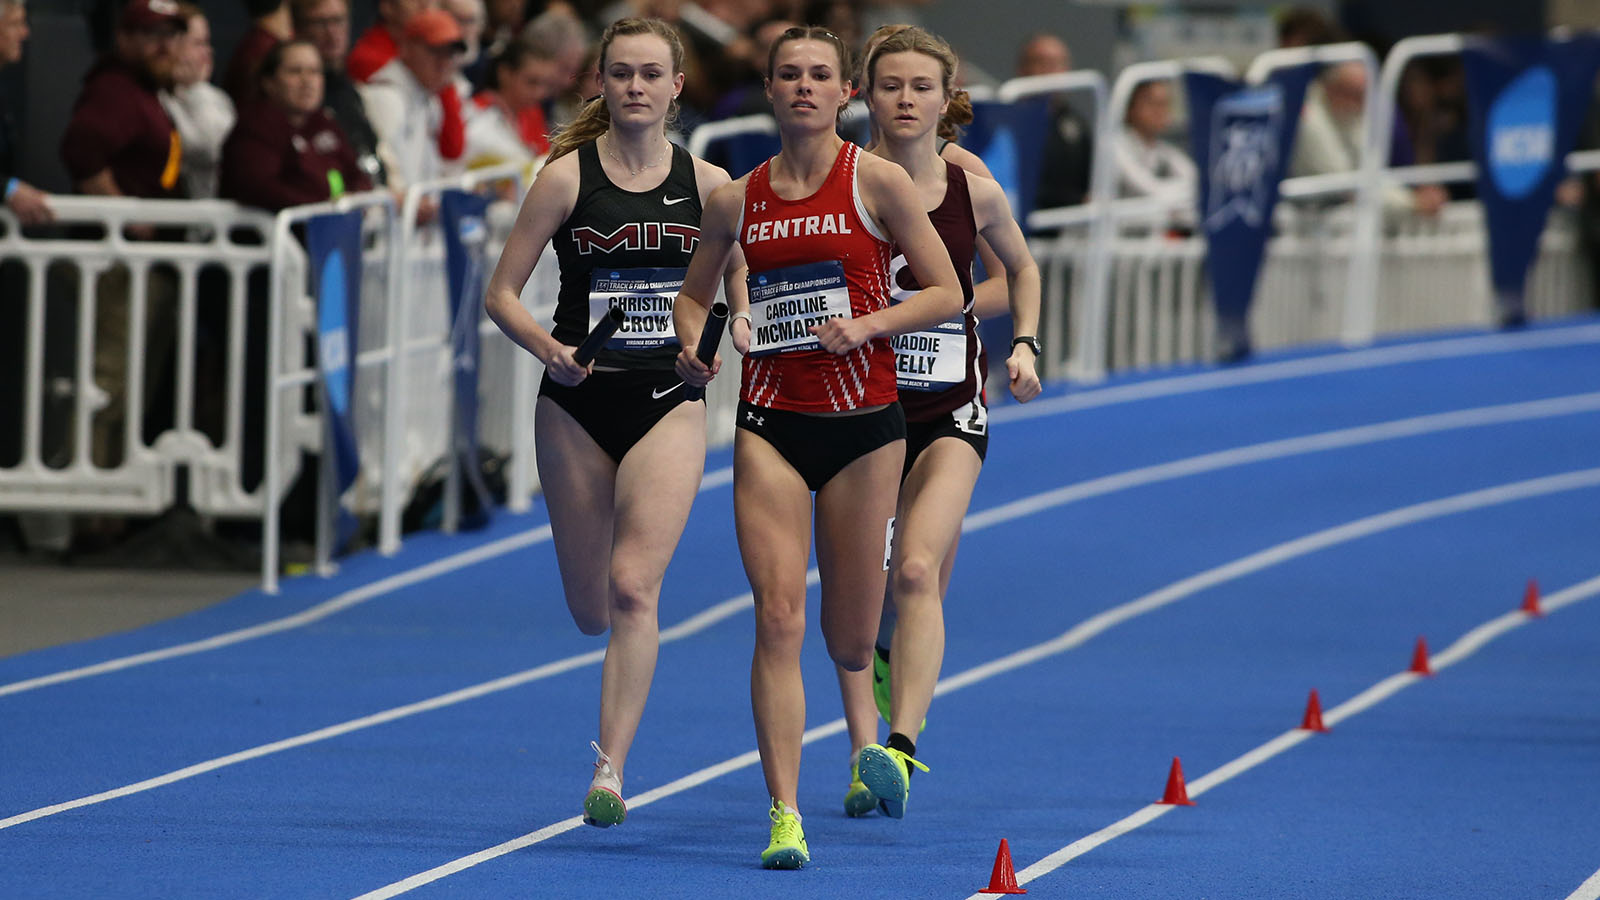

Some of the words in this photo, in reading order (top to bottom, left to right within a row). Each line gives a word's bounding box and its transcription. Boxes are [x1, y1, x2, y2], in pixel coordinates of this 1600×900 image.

[571, 222, 701, 255] MIT
[746, 213, 852, 245] CENTRAL
[610, 282, 627, 290] TRACK
[634, 282, 649, 290] FIELD
[761, 286, 775, 297] TRACK
[779, 283, 793, 292] FIELD
[794, 276, 841, 290] CHAMPIONSHIPS
[608, 297, 673, 311] CHRISTIN
[766, 295, 828, 320] CAROLINE
[620, 315, 670, 332] CROW
[757, 313, 844, 345] MCMART
[889, 335, 940, 353] MADDIE
